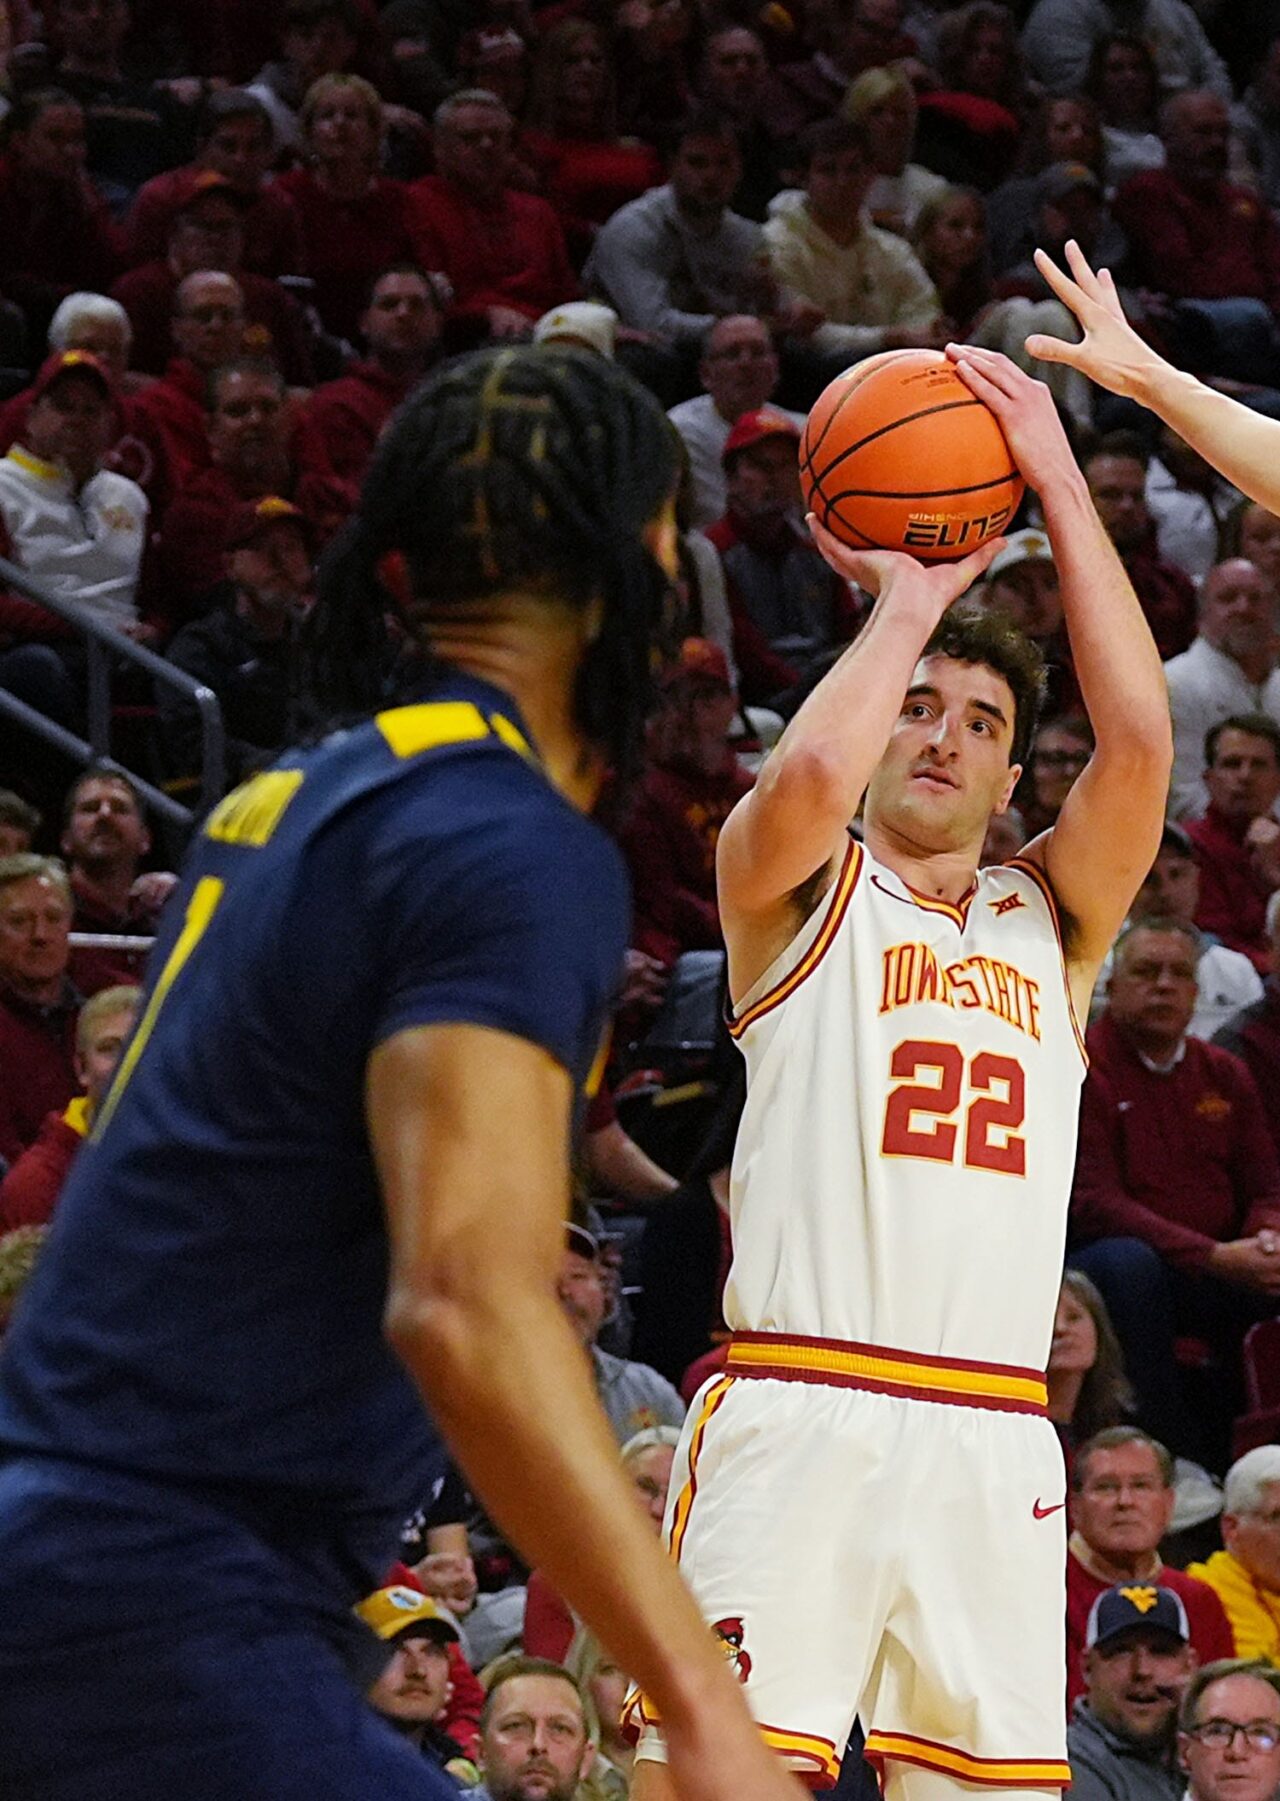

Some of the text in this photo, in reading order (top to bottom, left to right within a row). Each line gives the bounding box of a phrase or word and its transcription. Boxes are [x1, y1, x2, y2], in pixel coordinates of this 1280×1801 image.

[903, 505, 1012, 547] ELITE
[944, 954, 1041, 1046] STATE
[879, 1038, 1027, 1180] 22
